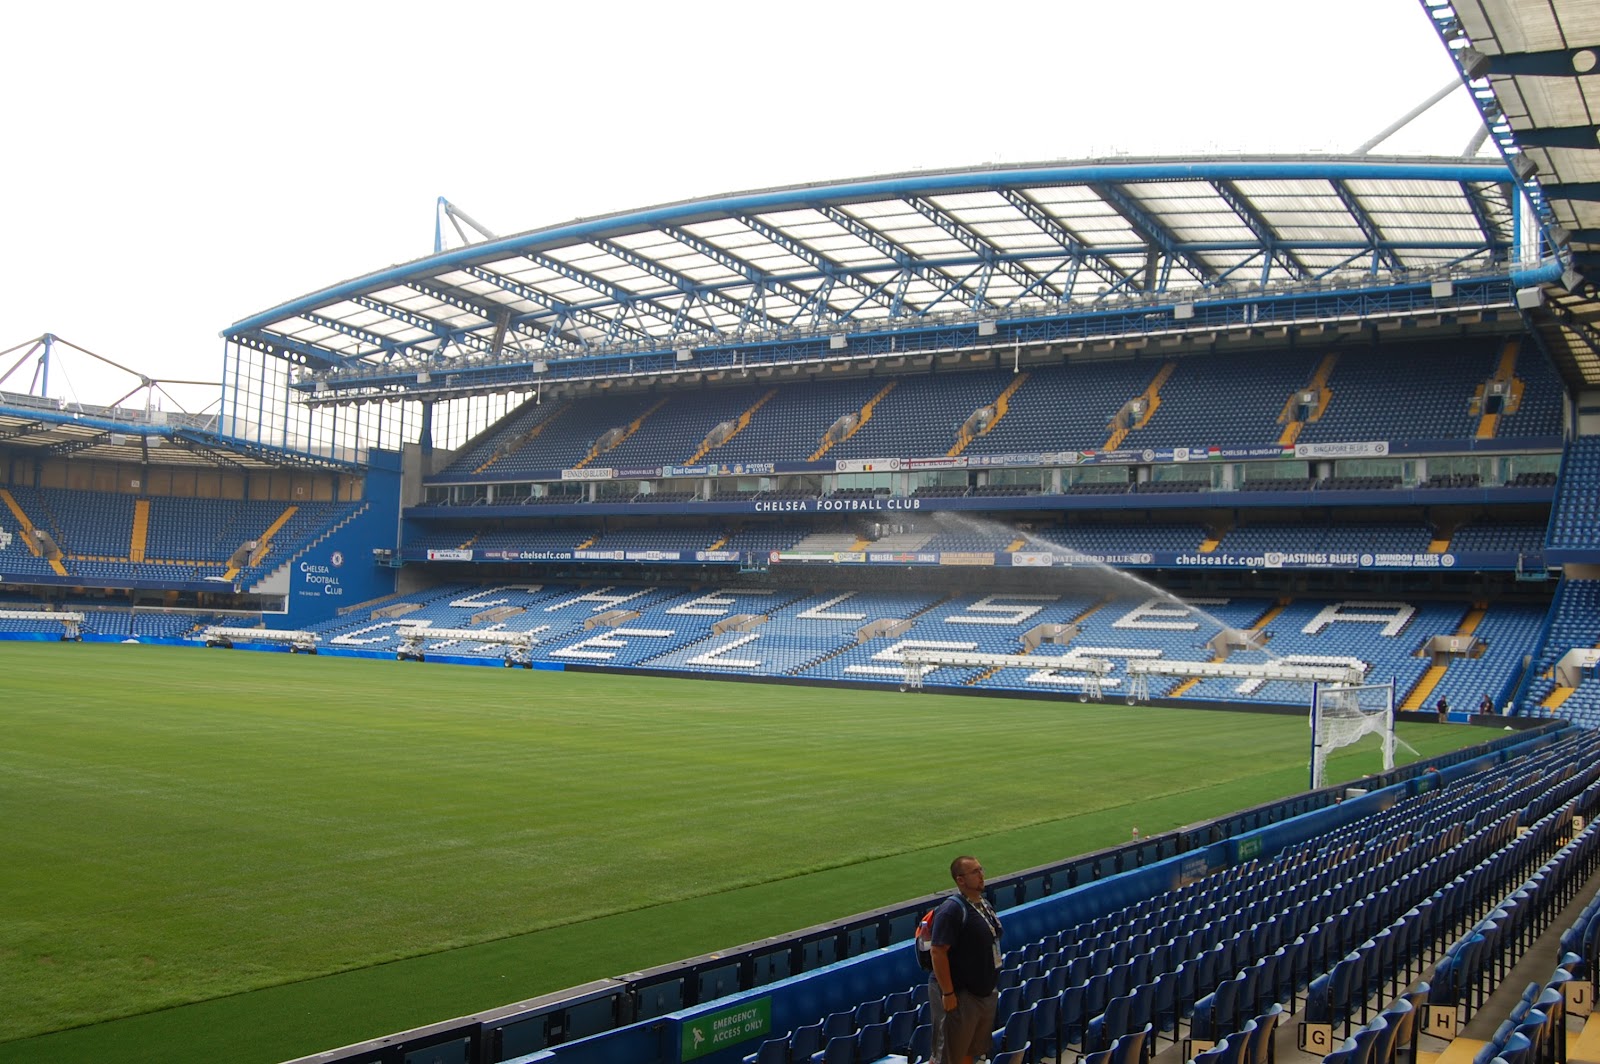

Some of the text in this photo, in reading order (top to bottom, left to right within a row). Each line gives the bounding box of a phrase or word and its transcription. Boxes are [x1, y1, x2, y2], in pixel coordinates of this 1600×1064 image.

[1249, 448, 1282, 456] HUNGARY
[672, 466, 707, 475] East Cornwall
[755, 499, 921, 512] CHELSEA FOOTBALL CLUB
[519, 550, 571, 560] chelseafc.com
[870, 553, 894, 562] CHELSEA
[918, 553, 935, 562] LINCS
[1052, 554, 1105, 563] WATERFORD
[1106, 554, 1134, 563] BLUES
[1175, 553, 1265, 566] chelseafc.com
[1282, 553, 1358, 564] HASTINGS BLUES
[1374, 553, 1440, 561] SWINDON BLUES
[300, 561, 329, 573] CHELSEA
[305, 573, 339, 585] FOOTBALL
[324, 584, 343, 595] CLUB
[1573, 989, 1584, 1004] J
[713, 1008, 757, 1031] EMERGENCY
[1437, 1013, 1450, 1029] H
[712, 1019, 763, 1044] ACCESS ONLY
[1311, 1030, 1325, 1045] G
